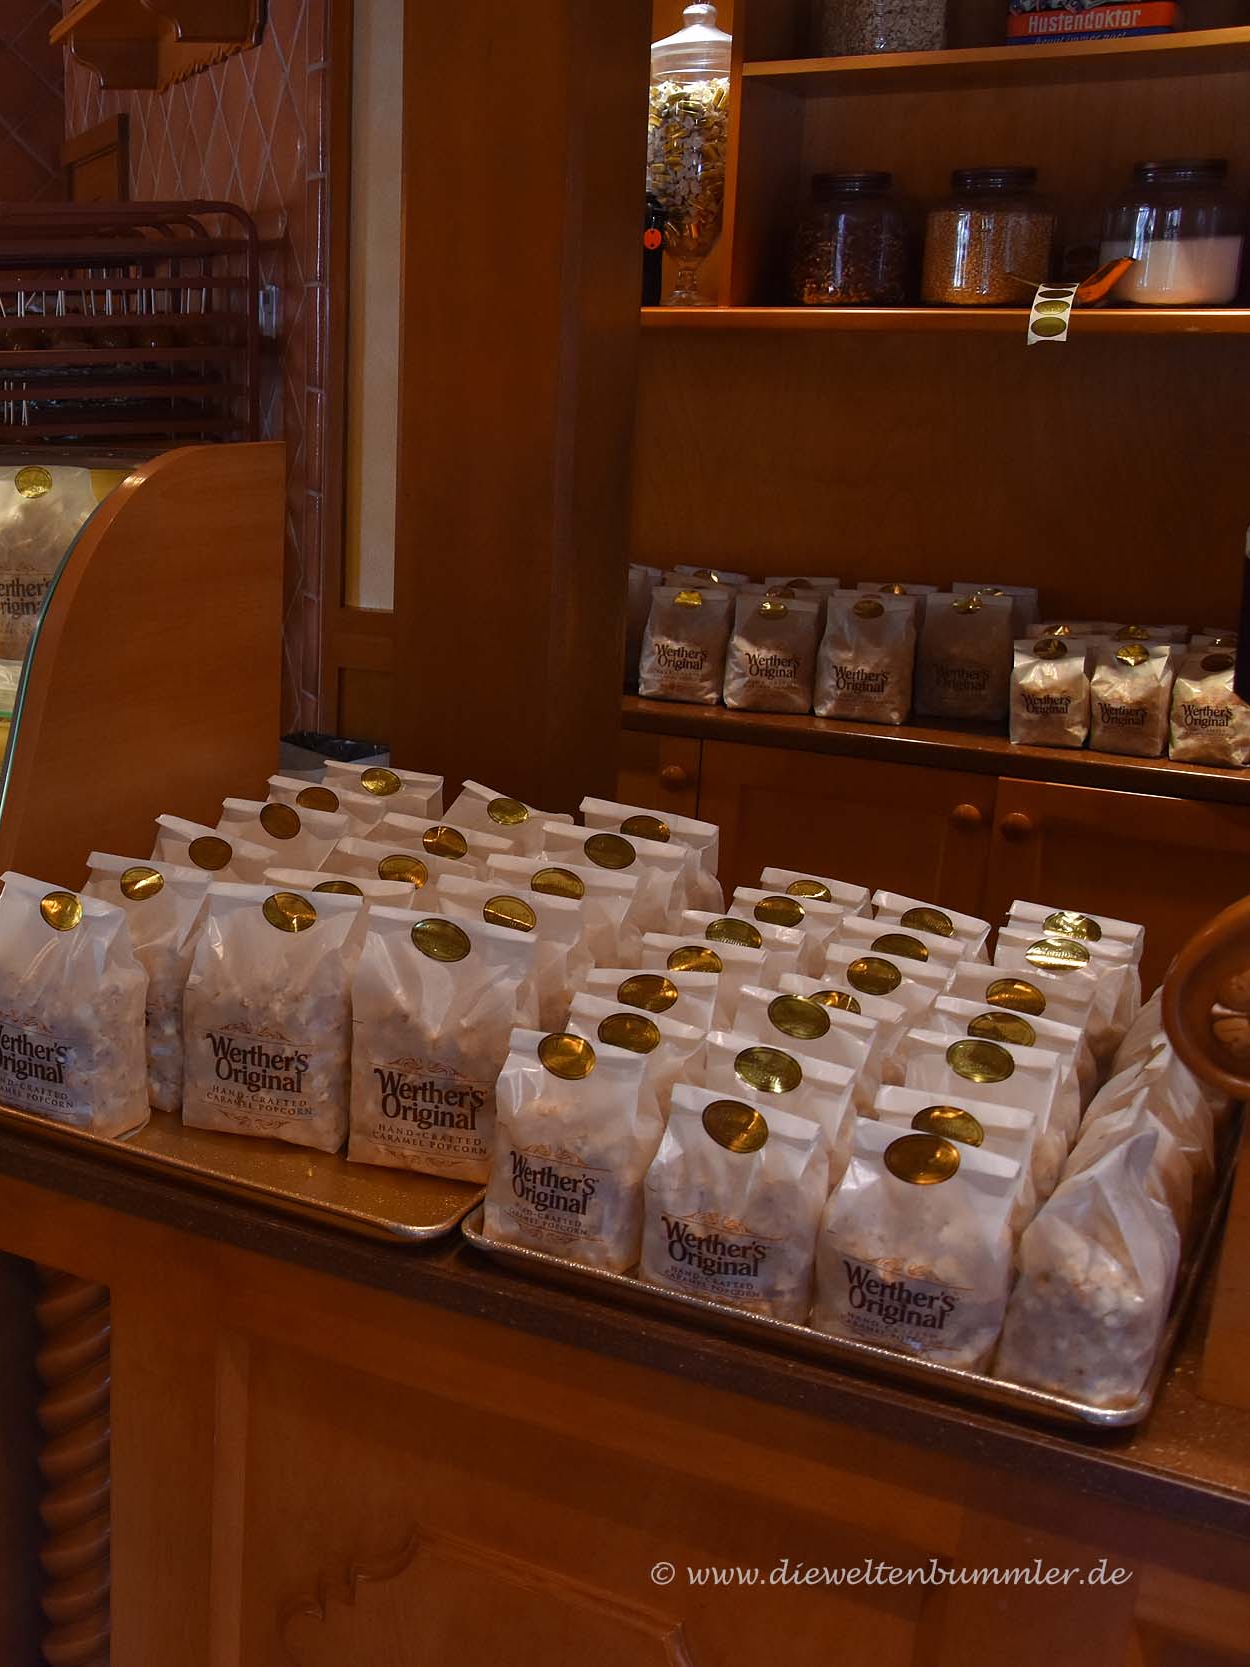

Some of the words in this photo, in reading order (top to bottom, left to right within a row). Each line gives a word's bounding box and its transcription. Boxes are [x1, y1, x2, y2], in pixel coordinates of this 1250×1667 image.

[1028, 9, 1142, 33] Hustendoktor
[654, 643, 707, 660] Werther's
[657, 655, 703, 671] Original
[745, 652, 799, 668] Werther's
[749, 665, 797, 680] Original
[832, 665, 889, 681] Werther's
[836, 678, 884, 693] Original
[1022, 693, 1070, 706] Werther's
[1026, 703, 1068, 716] Original
[1098, 702, 1148, 718] Werther's
[1182, 704, 1233, 718] Werther's
[1101, 713, 1144, 728] Original
[1185, 715, 1229, 729] Original
[206, 1032, 310, 1073] Werther's
[215, 1056, 303, 1093] Original
[212, 1084, 308, 1108] HAND-CRAFTED
[373, 1067, 486, 1109] Werther's
[26, 1093, 74, 1109] POPCORN
[206, 1091, 253, 1110] CARAMEL
[258, 1103, 312, 1116] POPCORN
[381, 1092, 477, 1131] Original
[372, 1130, 426, 1147] CARAMEL
[429, 1141, 487, 1155] POPCORN
[378, 1123, 482, 1146] HAND-CRAFTED
[510, 1150, 596, 1196] Werther's
[512, 1174, 587, 1216] Original
[661, 1215, 767, 1260] Werther's
[668, 1239, 759, 1277] Original
[842, 1259, 955, 1313] Werther's
[849, 1284, 944, 1330] Original
